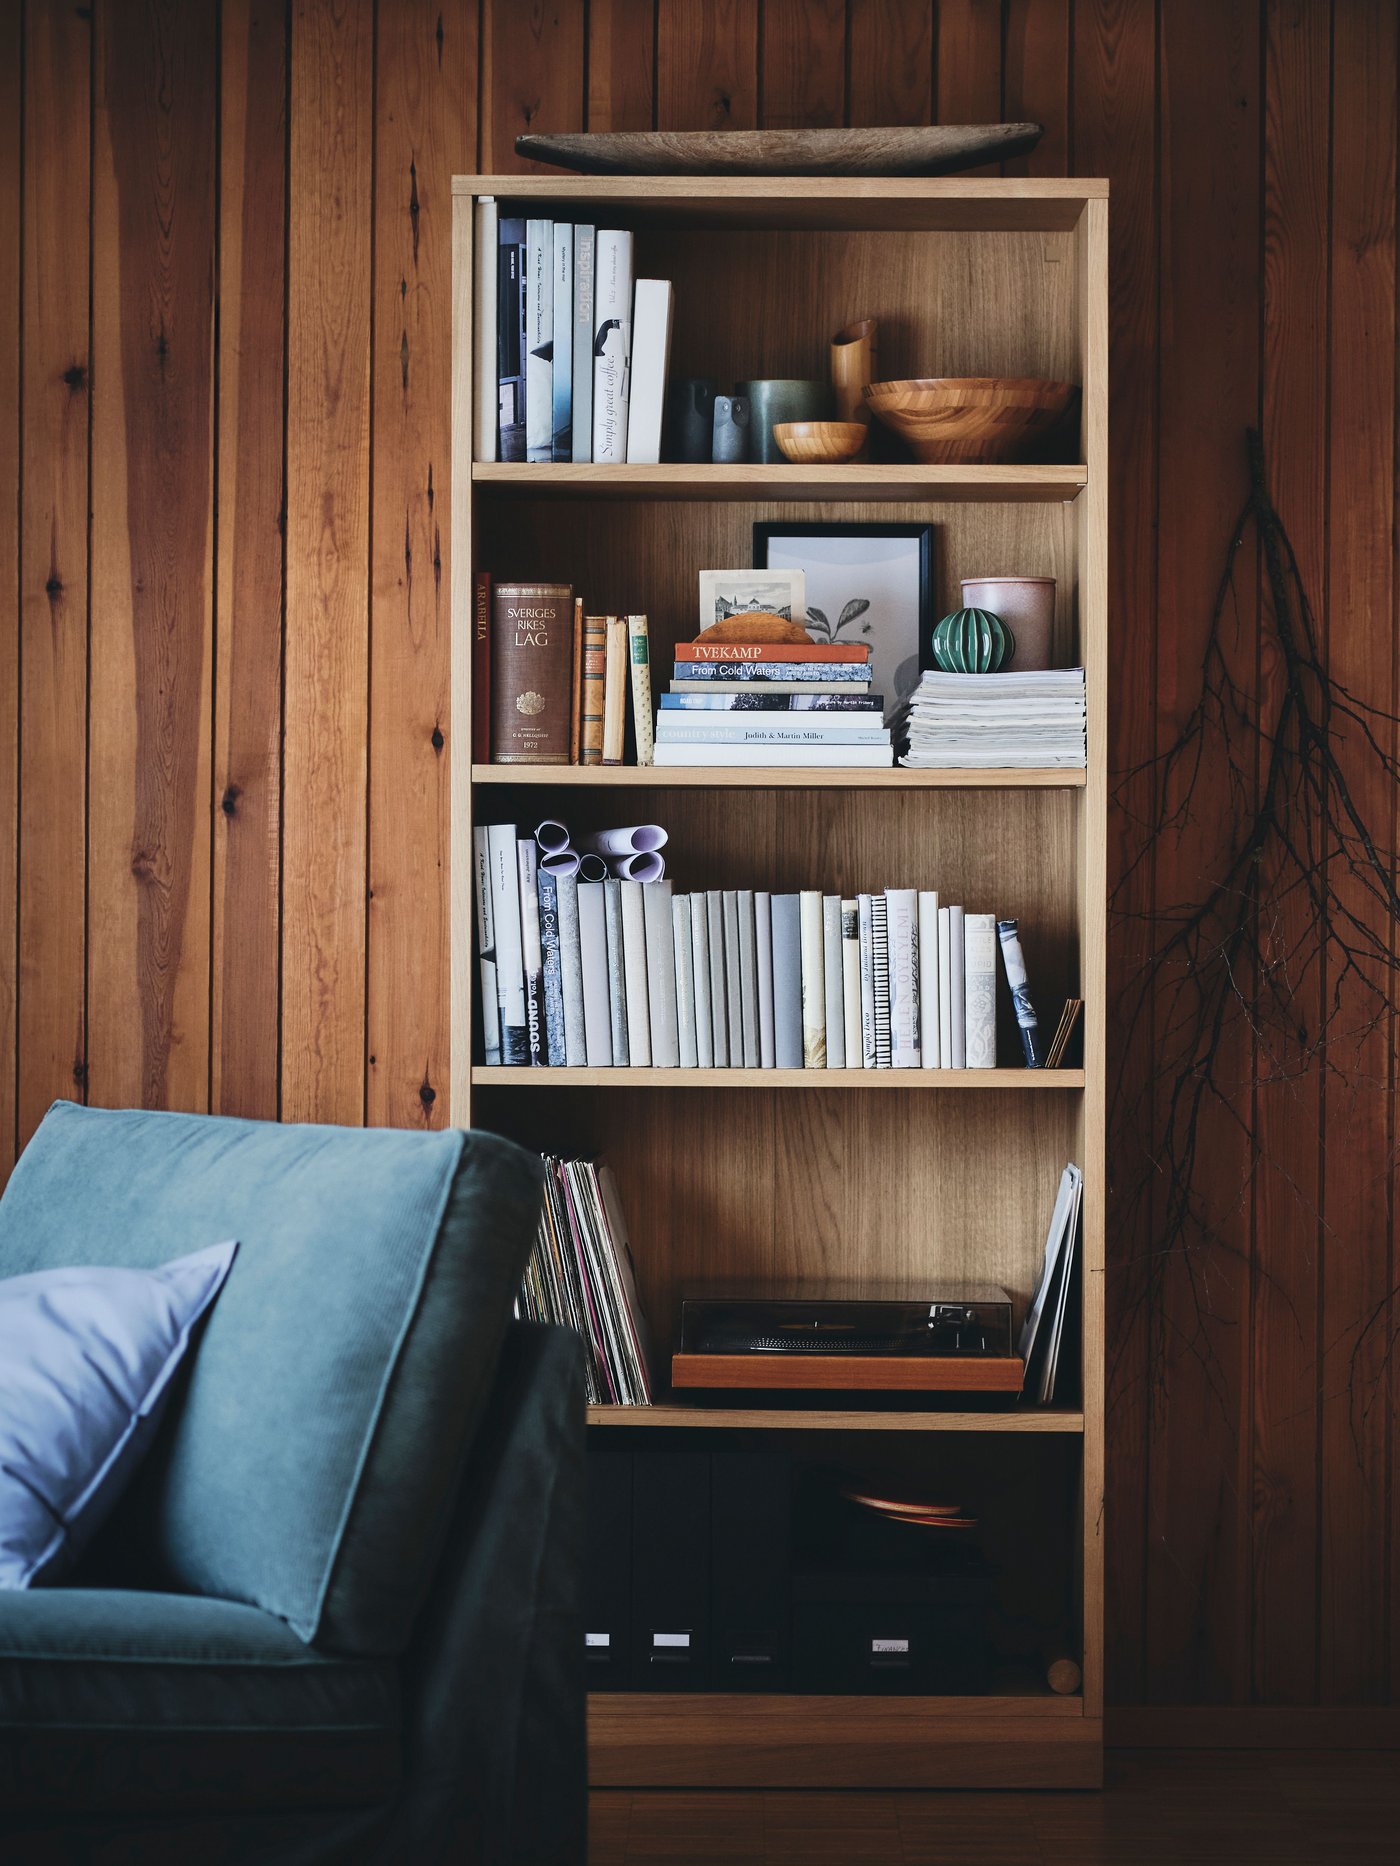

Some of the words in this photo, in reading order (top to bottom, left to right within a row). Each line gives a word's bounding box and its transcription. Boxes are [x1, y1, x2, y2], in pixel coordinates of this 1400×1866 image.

[579, 236, 593, 322] Inspiration
[600, 355, 618, 386] coffee.
[605, 389, 617, 416] great
[600, 418, 617, 456] Simply
[477, 584, 486, 640] ARABELLA
[507, 608, 556, 618] SVERIGES
[517, 620, 546, 630] RIKES
[515, 632, 548, 646] LAG
[692, 646, 762, 658] TVEKAMP
[692, 665, 716, 676] From
[719, 665, 743, 676] Cold
[745, 665, 780, 676] Waters
[523, 741, 538, 749] 1972
[662, 729, 709, 739] country
[709, 728, 736, 739] style
[744, 731, 767, 740] Judith
[769, 732, 775, 740] &
[777, 732, 801, 740] Martin
[803, 732, 824, 740] Miller
[543, 886, 552, 911] From
[545, 913, 554, 936] Cold
[546, 938, 556, 975] Waters
[897, 907, 909, 983] OYEYEMI
[528, 1000, 540, 1053] SOUND
[900, 993, 910, 1049] HELEN
